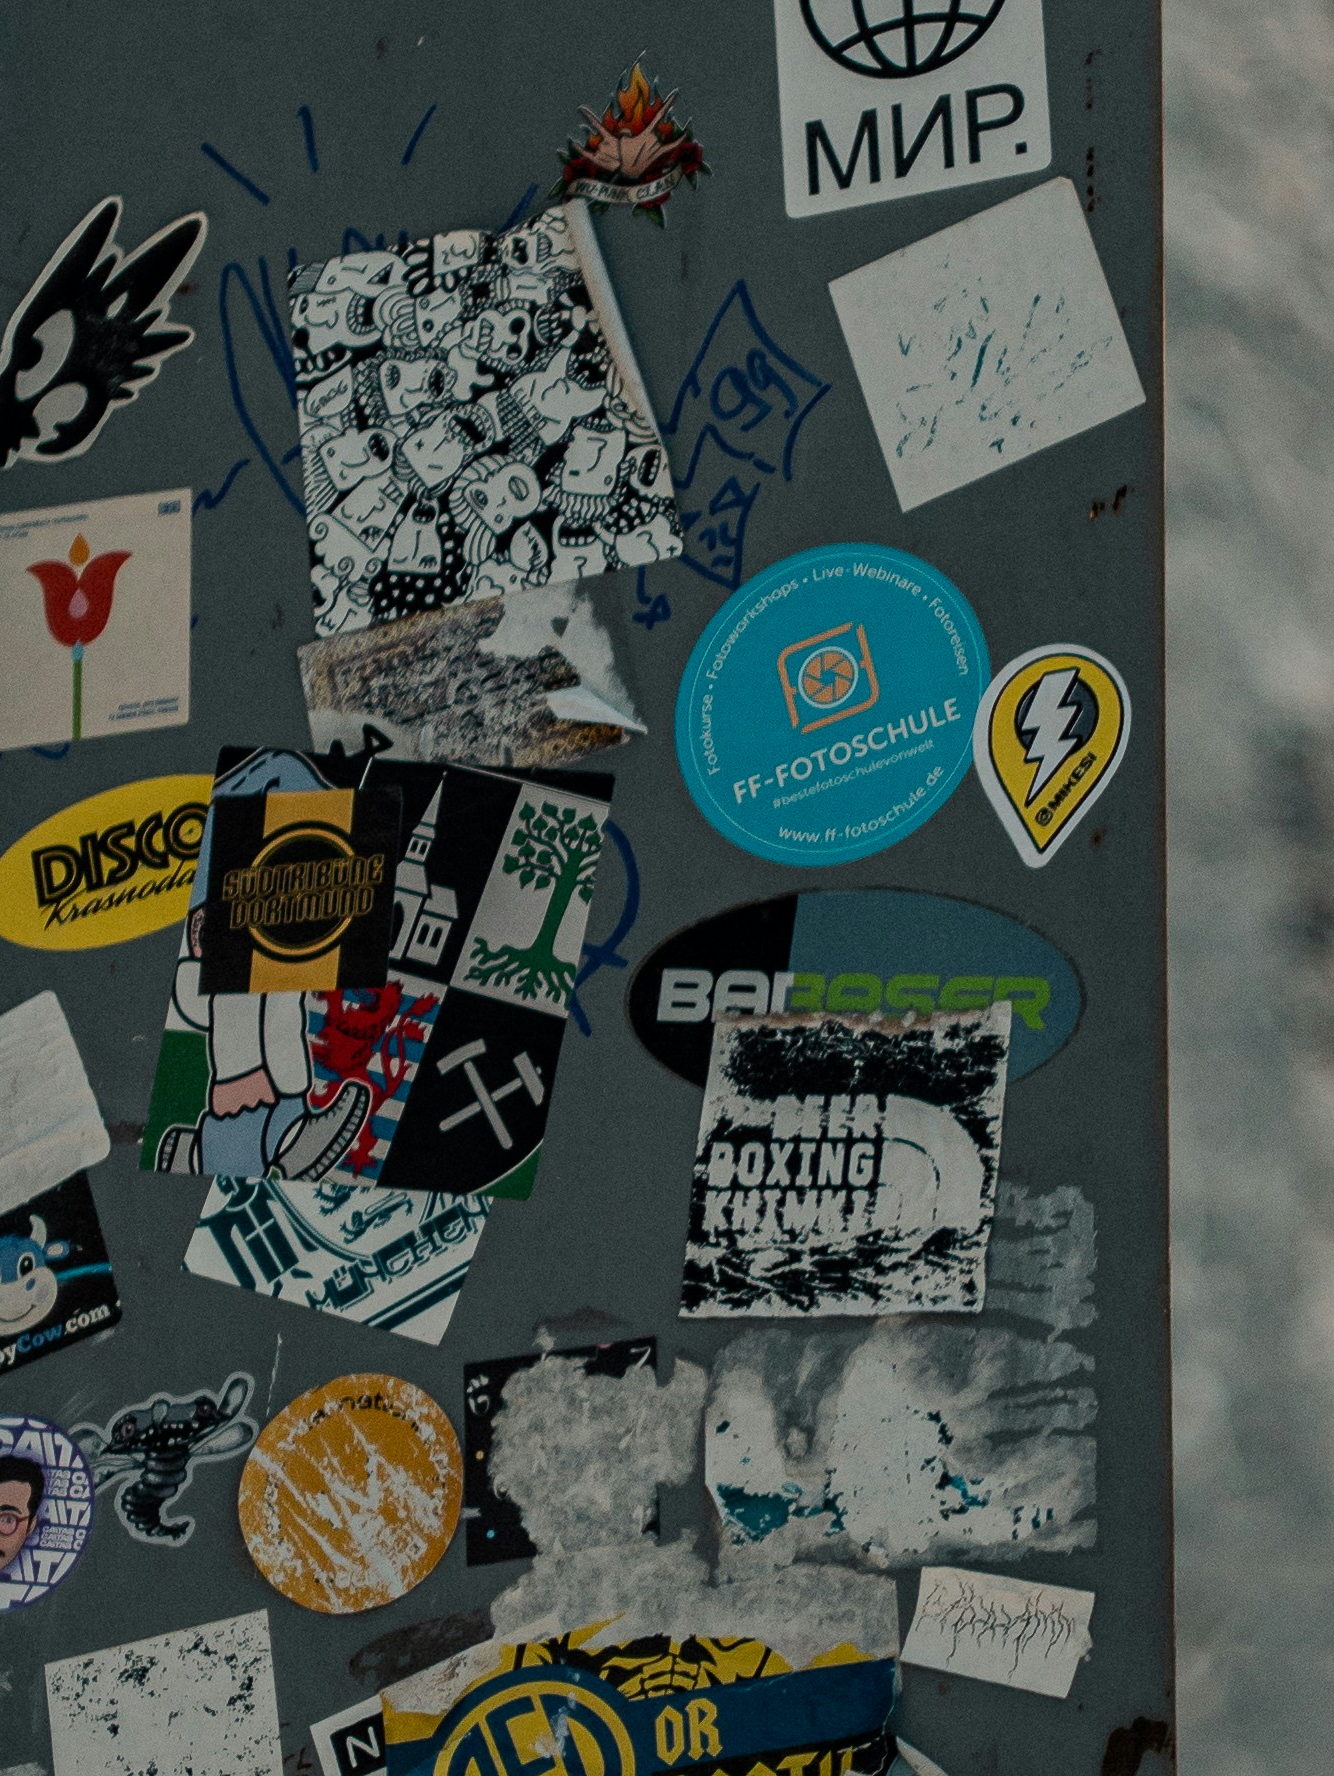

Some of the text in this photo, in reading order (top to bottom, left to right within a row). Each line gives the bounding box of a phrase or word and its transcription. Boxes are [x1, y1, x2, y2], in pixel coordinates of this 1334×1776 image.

[805, 83, 1028, 196] МИР.
[706, 578, 799, 680] Fotoworkshops
[701, 693, 721, 776] Fotokurse
[732, 697, 961, 805] FF-FOTOSCHULE
[32, 802, 210, 908] DISCO
[709, 1140, 876, 1187] BOXING
[656, 1696, 723, 1766] OR
